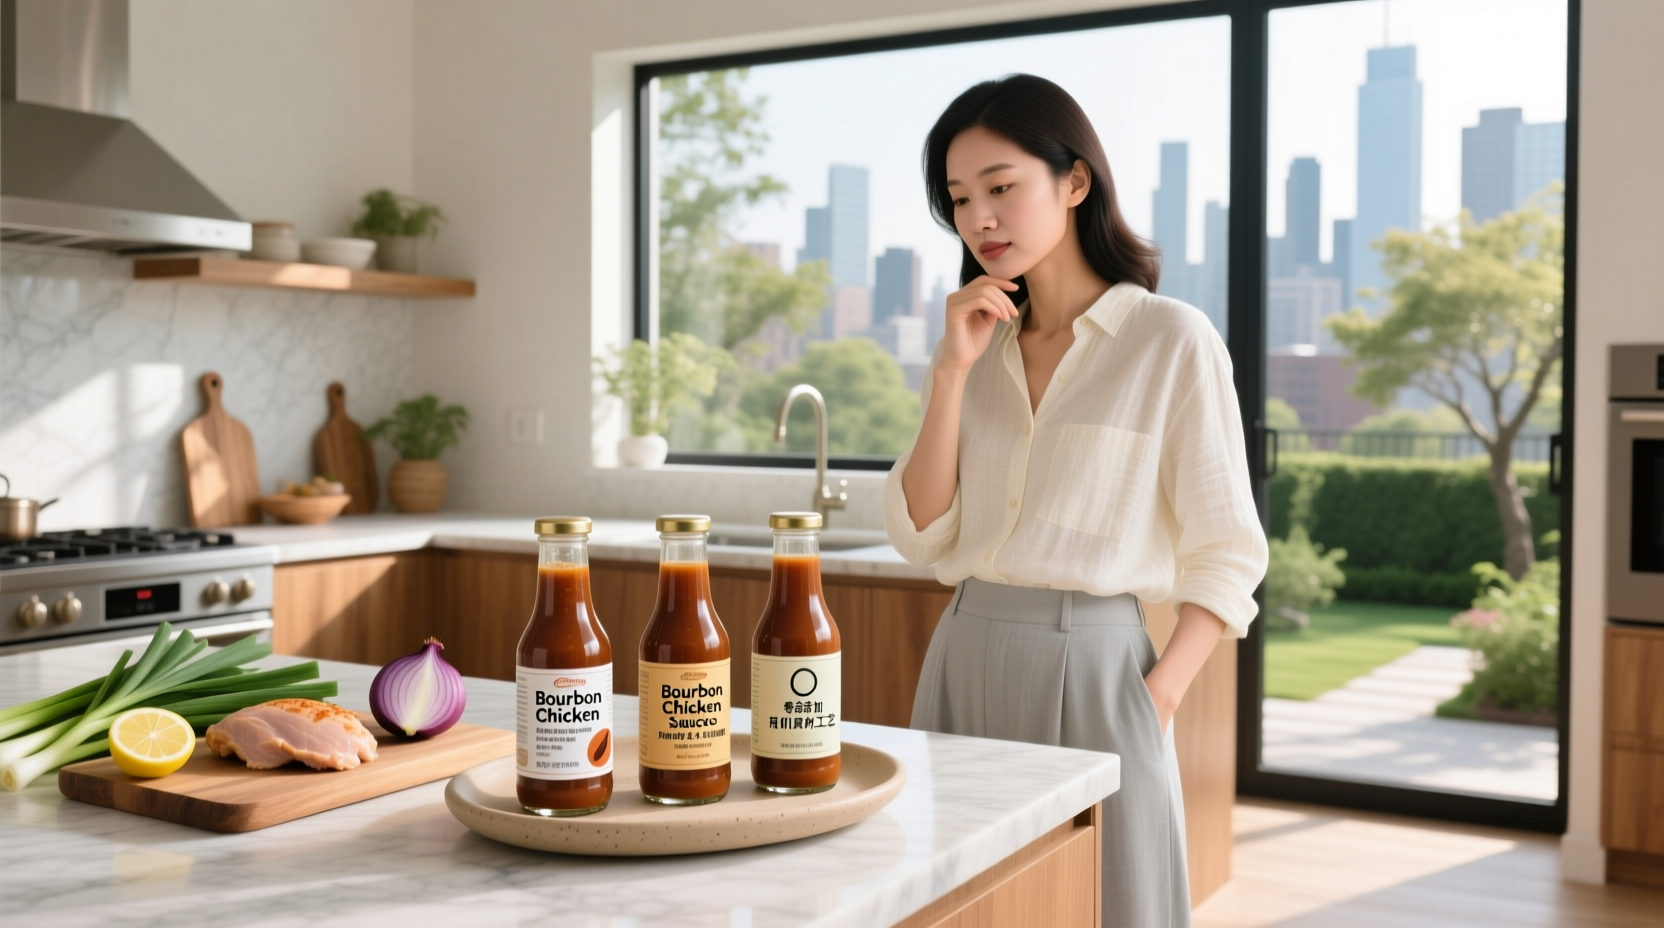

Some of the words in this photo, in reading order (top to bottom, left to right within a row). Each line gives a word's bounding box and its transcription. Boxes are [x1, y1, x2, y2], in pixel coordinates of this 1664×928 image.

[535, 690, 602, 706] Bourbon
[661, 683, 723, 699] Bourbon
[535, 707, 600, 723] Chicken
[662, 700, 722, 715] Chicken
